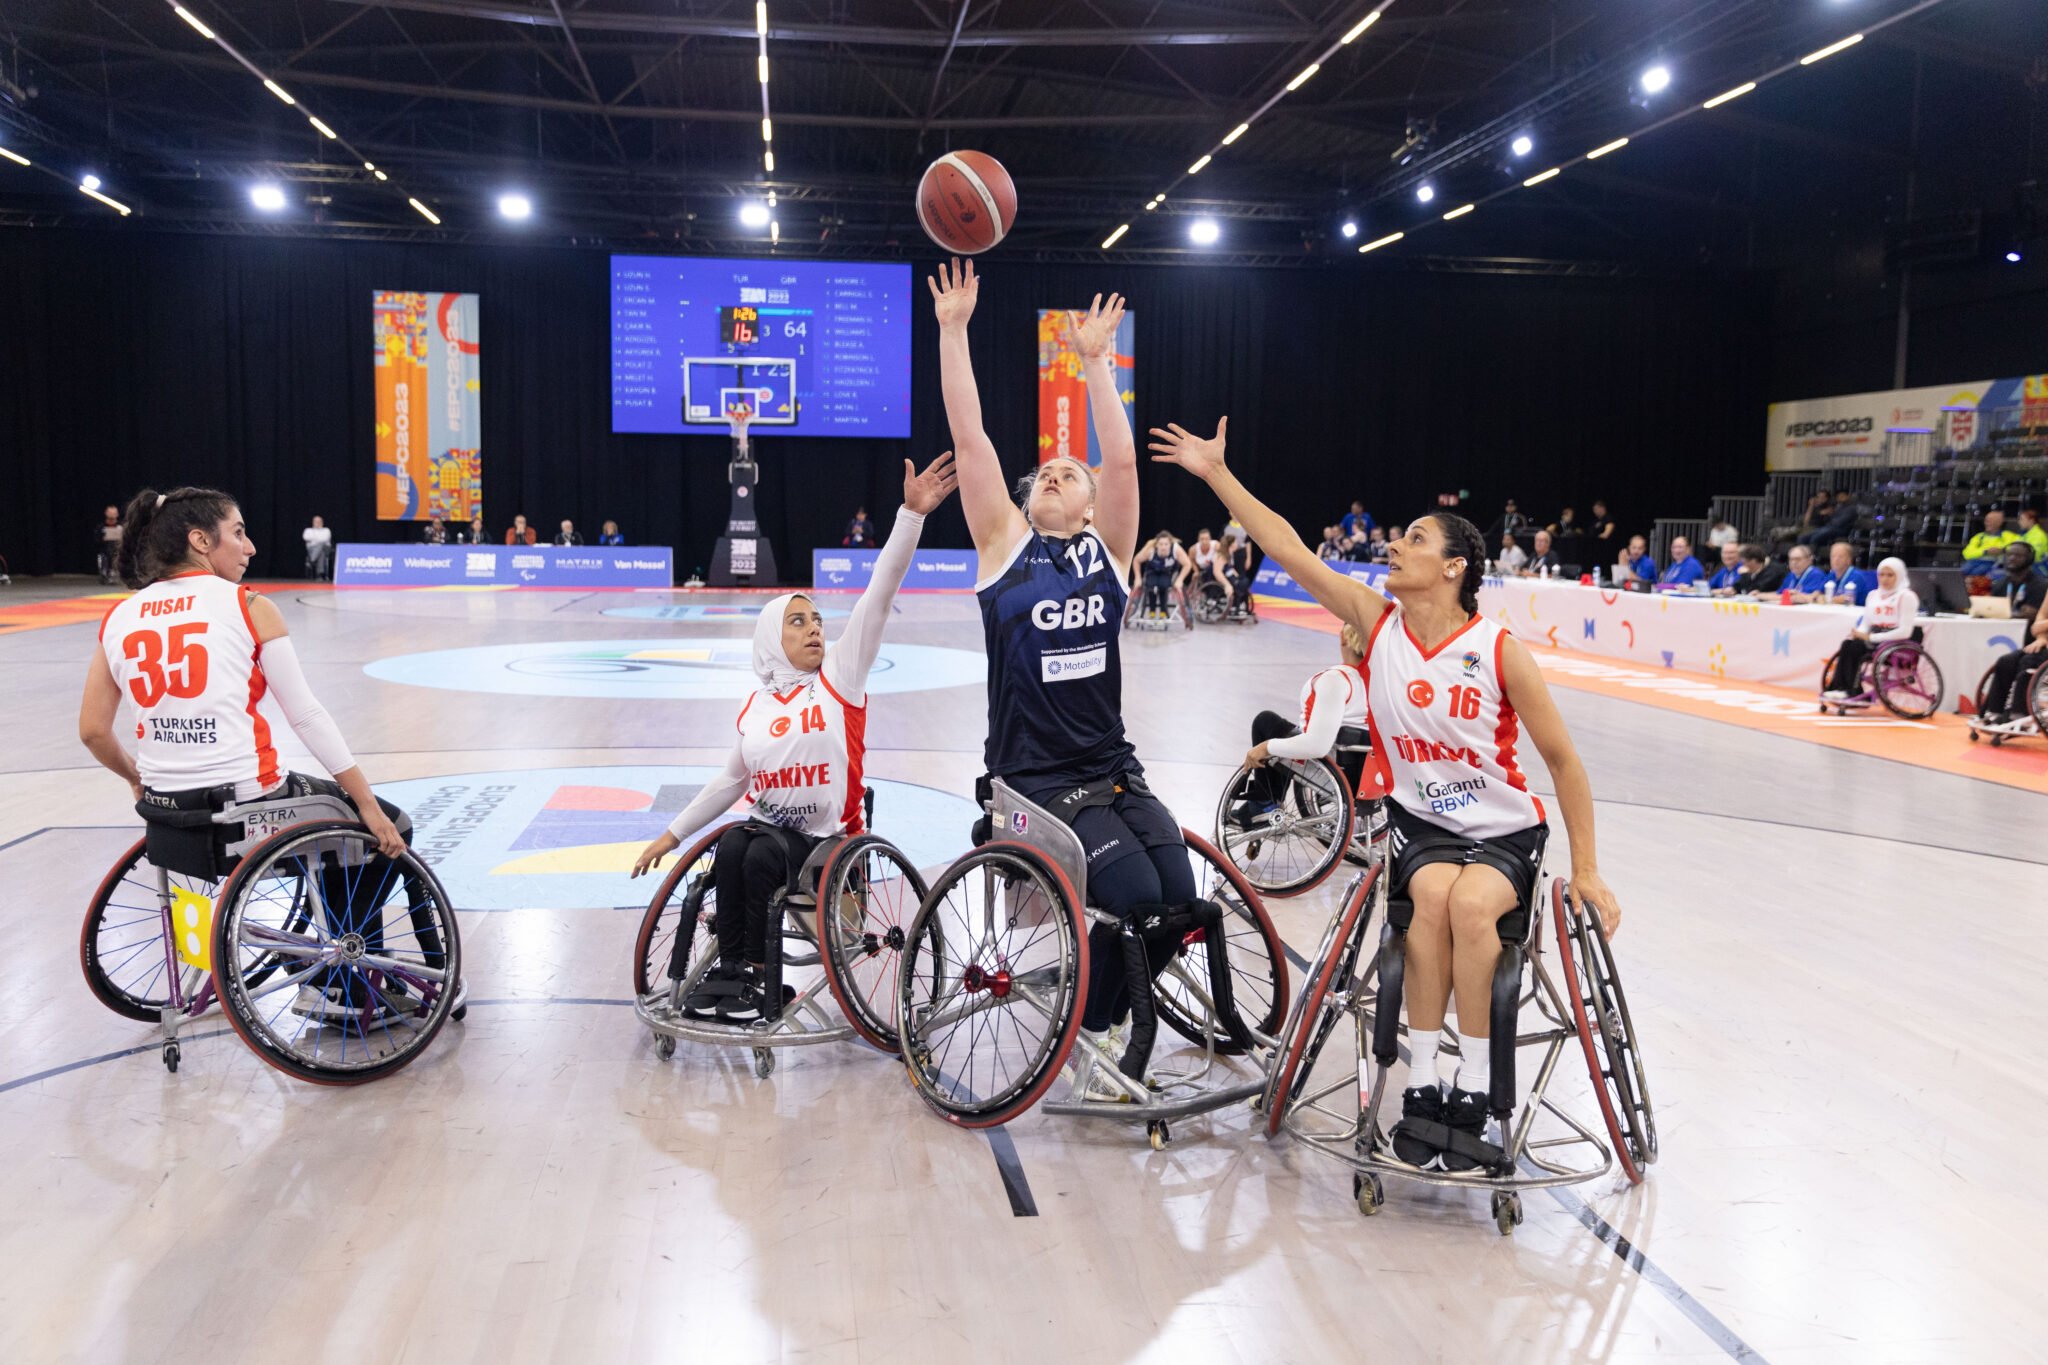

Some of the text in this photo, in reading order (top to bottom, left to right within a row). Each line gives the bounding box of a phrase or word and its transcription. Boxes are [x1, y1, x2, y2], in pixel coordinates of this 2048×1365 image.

[733, 274, 749, 283] TUR
[780, 277, 797, 285] GBR
[763, 325, 771, 338] 3
[784, 321, 807, 338] 64
[446, 309, 461, 432] #EPC2023
[1784, 416, 1874, 438] #EPC2023
[395, 382, 411, 505] #EPC2023
[346, 555, 393, 568] molten
[556, 558, 603, 567] MATRIX
[614, 559, 632, 570] Van
[917, 562, 935, 572] Van
[1064, 537, 1104, 578] 12
[140, 595, 196, 618] PUSAT
[1031, 594, 1107, 630] GBR
[122, 622, 209, 708] 35
[1064, 657, 1103, 671] Motability
[1448, 684, 1481, 720] 16
[149, 717, 217, 730] TURKISH
[800, 704, 826, 734] 14
[153, 730, 217, 744] AIRLINES
[1425, 776, 1487, 799] Garanti
[145, 791, 179, 810] EXTRA
[769, 803, 817, 815] Garanti
[1431, 791, 1479, 814] BBVA
[248, 808, 297, 825] EXTRA
[424, 841, 461, 866] PAR
[1090, 839, 1120, 859] KUKRI
